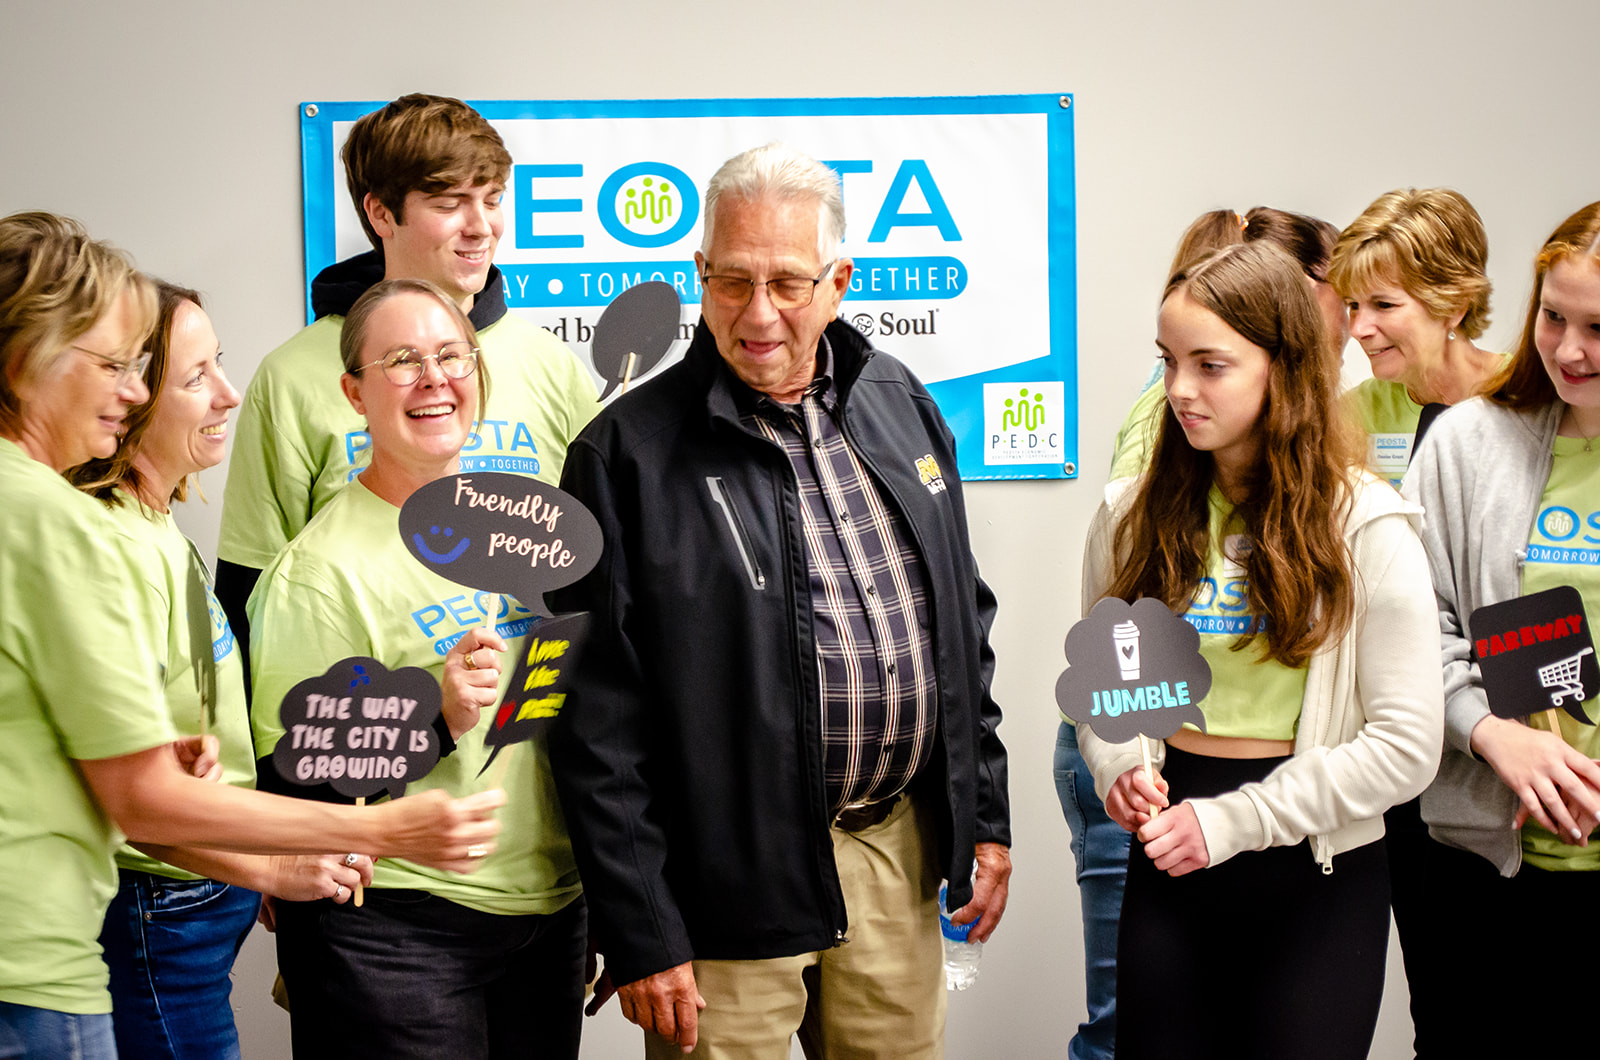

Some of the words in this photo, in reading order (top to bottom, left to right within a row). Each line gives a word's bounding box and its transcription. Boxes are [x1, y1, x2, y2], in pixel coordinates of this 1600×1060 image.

[514, 159, 963, 249] EOA
[849, 267, 959, 292] GETHER
[345, 420, 538, 465] PSTA
[491, 459, 539, 471] TOGETHER
[455, 478, 563, 532] Friendly
[488, 532, 576, 568] people
[411, 590, 531, 638] PEO
[1186, 617, 1236, 631] ORROW
[1476, 614, 1582, 658] FAREWAY
[305, 693, 352, 720] THE
[361, 696, 418, 722] WAY
[1091, 681, 1191, 717] JUMBLE
[291, 724, 336, 750] THE
[346, 725, 401, 751] CITY
[408, 729, 430, 753] IS
